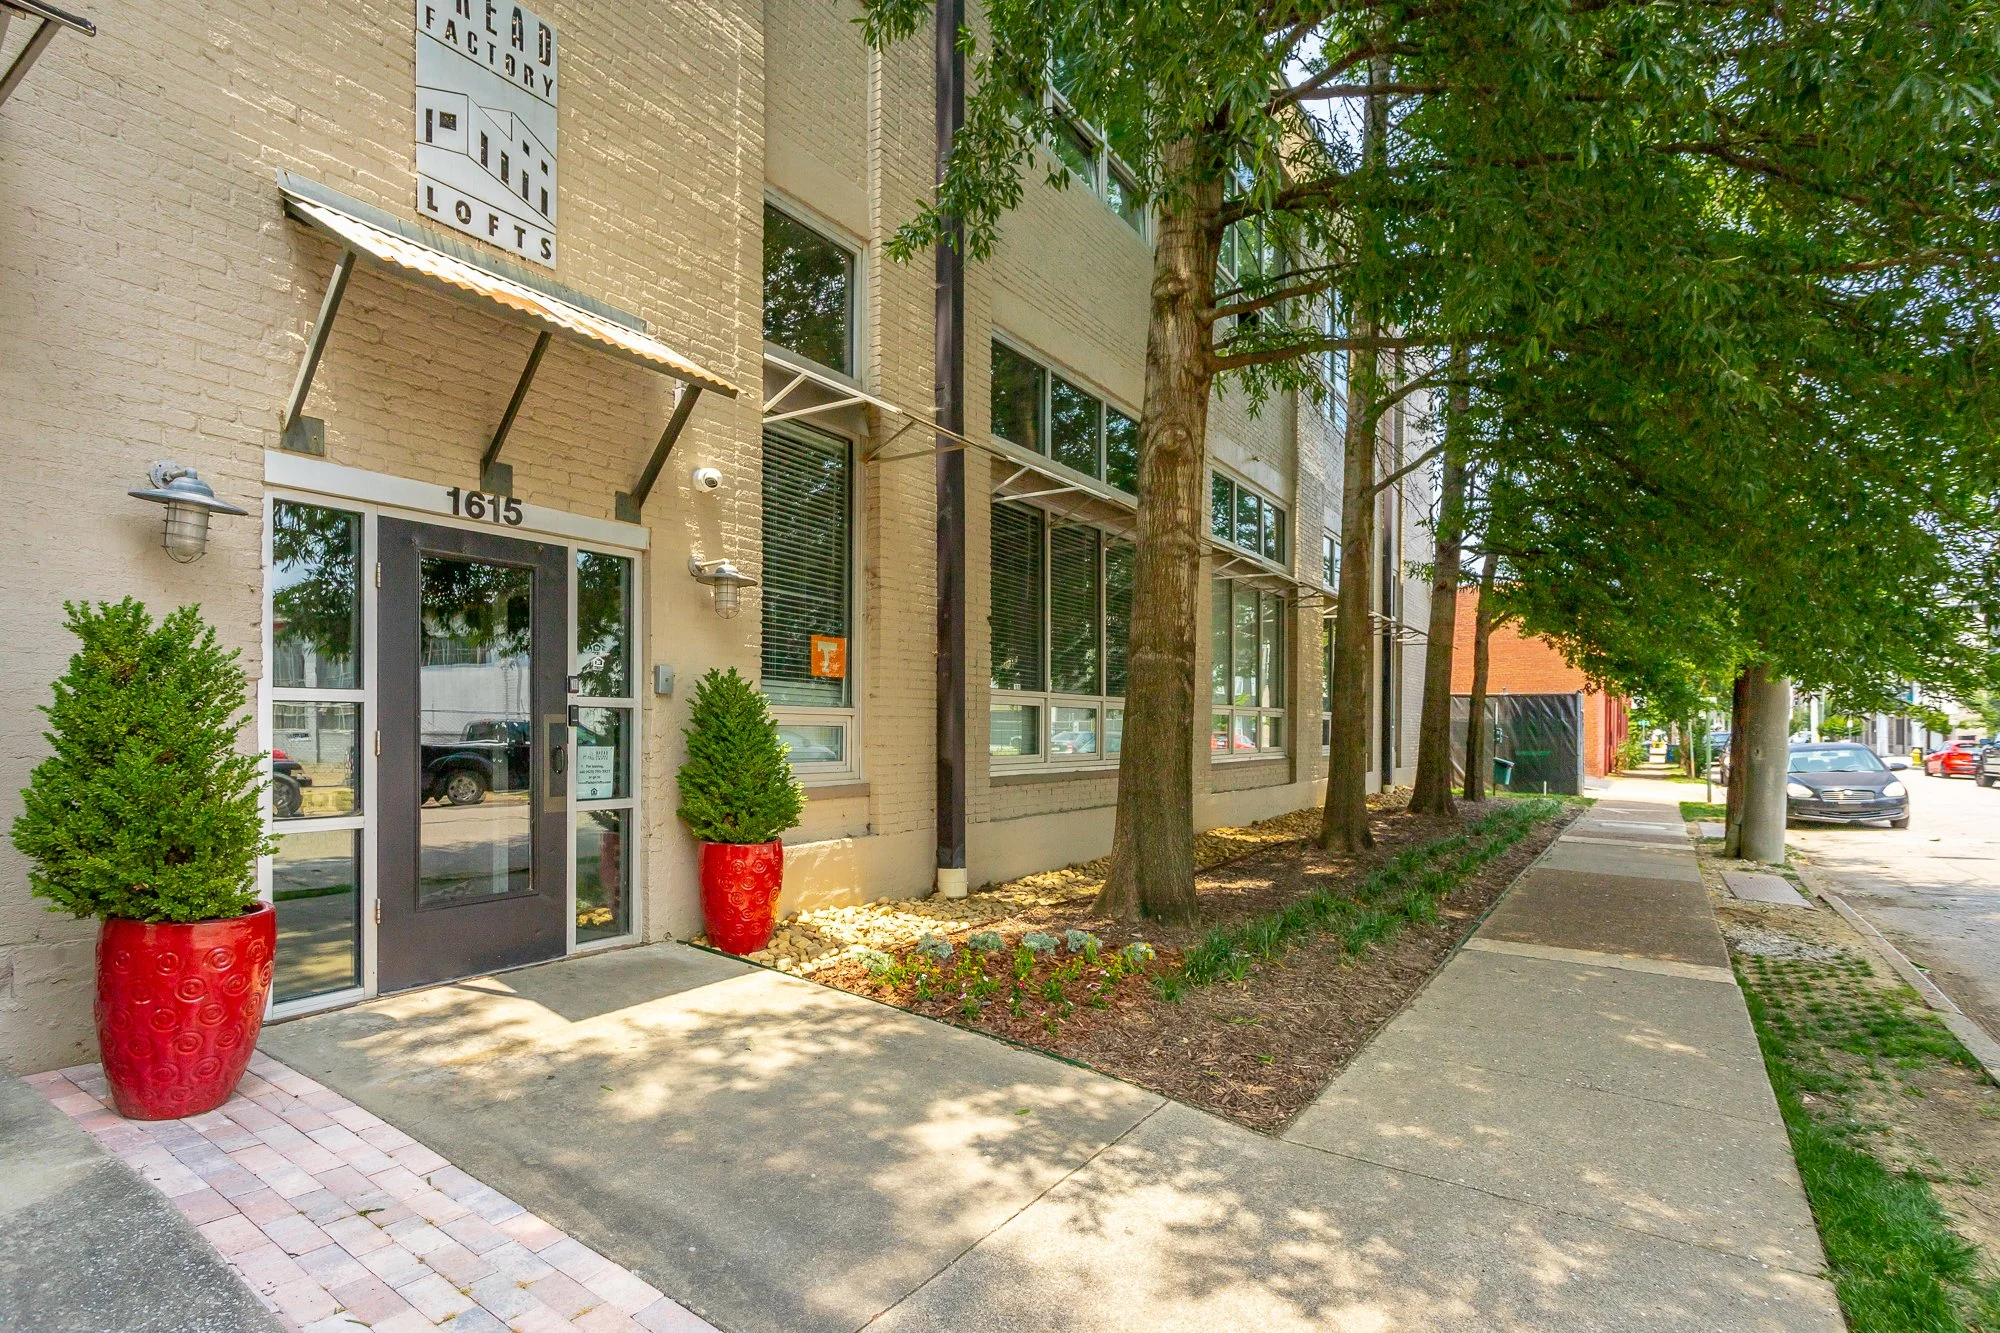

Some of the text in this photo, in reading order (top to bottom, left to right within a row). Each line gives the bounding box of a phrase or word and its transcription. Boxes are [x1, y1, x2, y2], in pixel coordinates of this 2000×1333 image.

[425, 5, 554, 98] FACTORY
[426, 185, 552, 260] LOFTS
[446, 486, 523, 526] 1615
